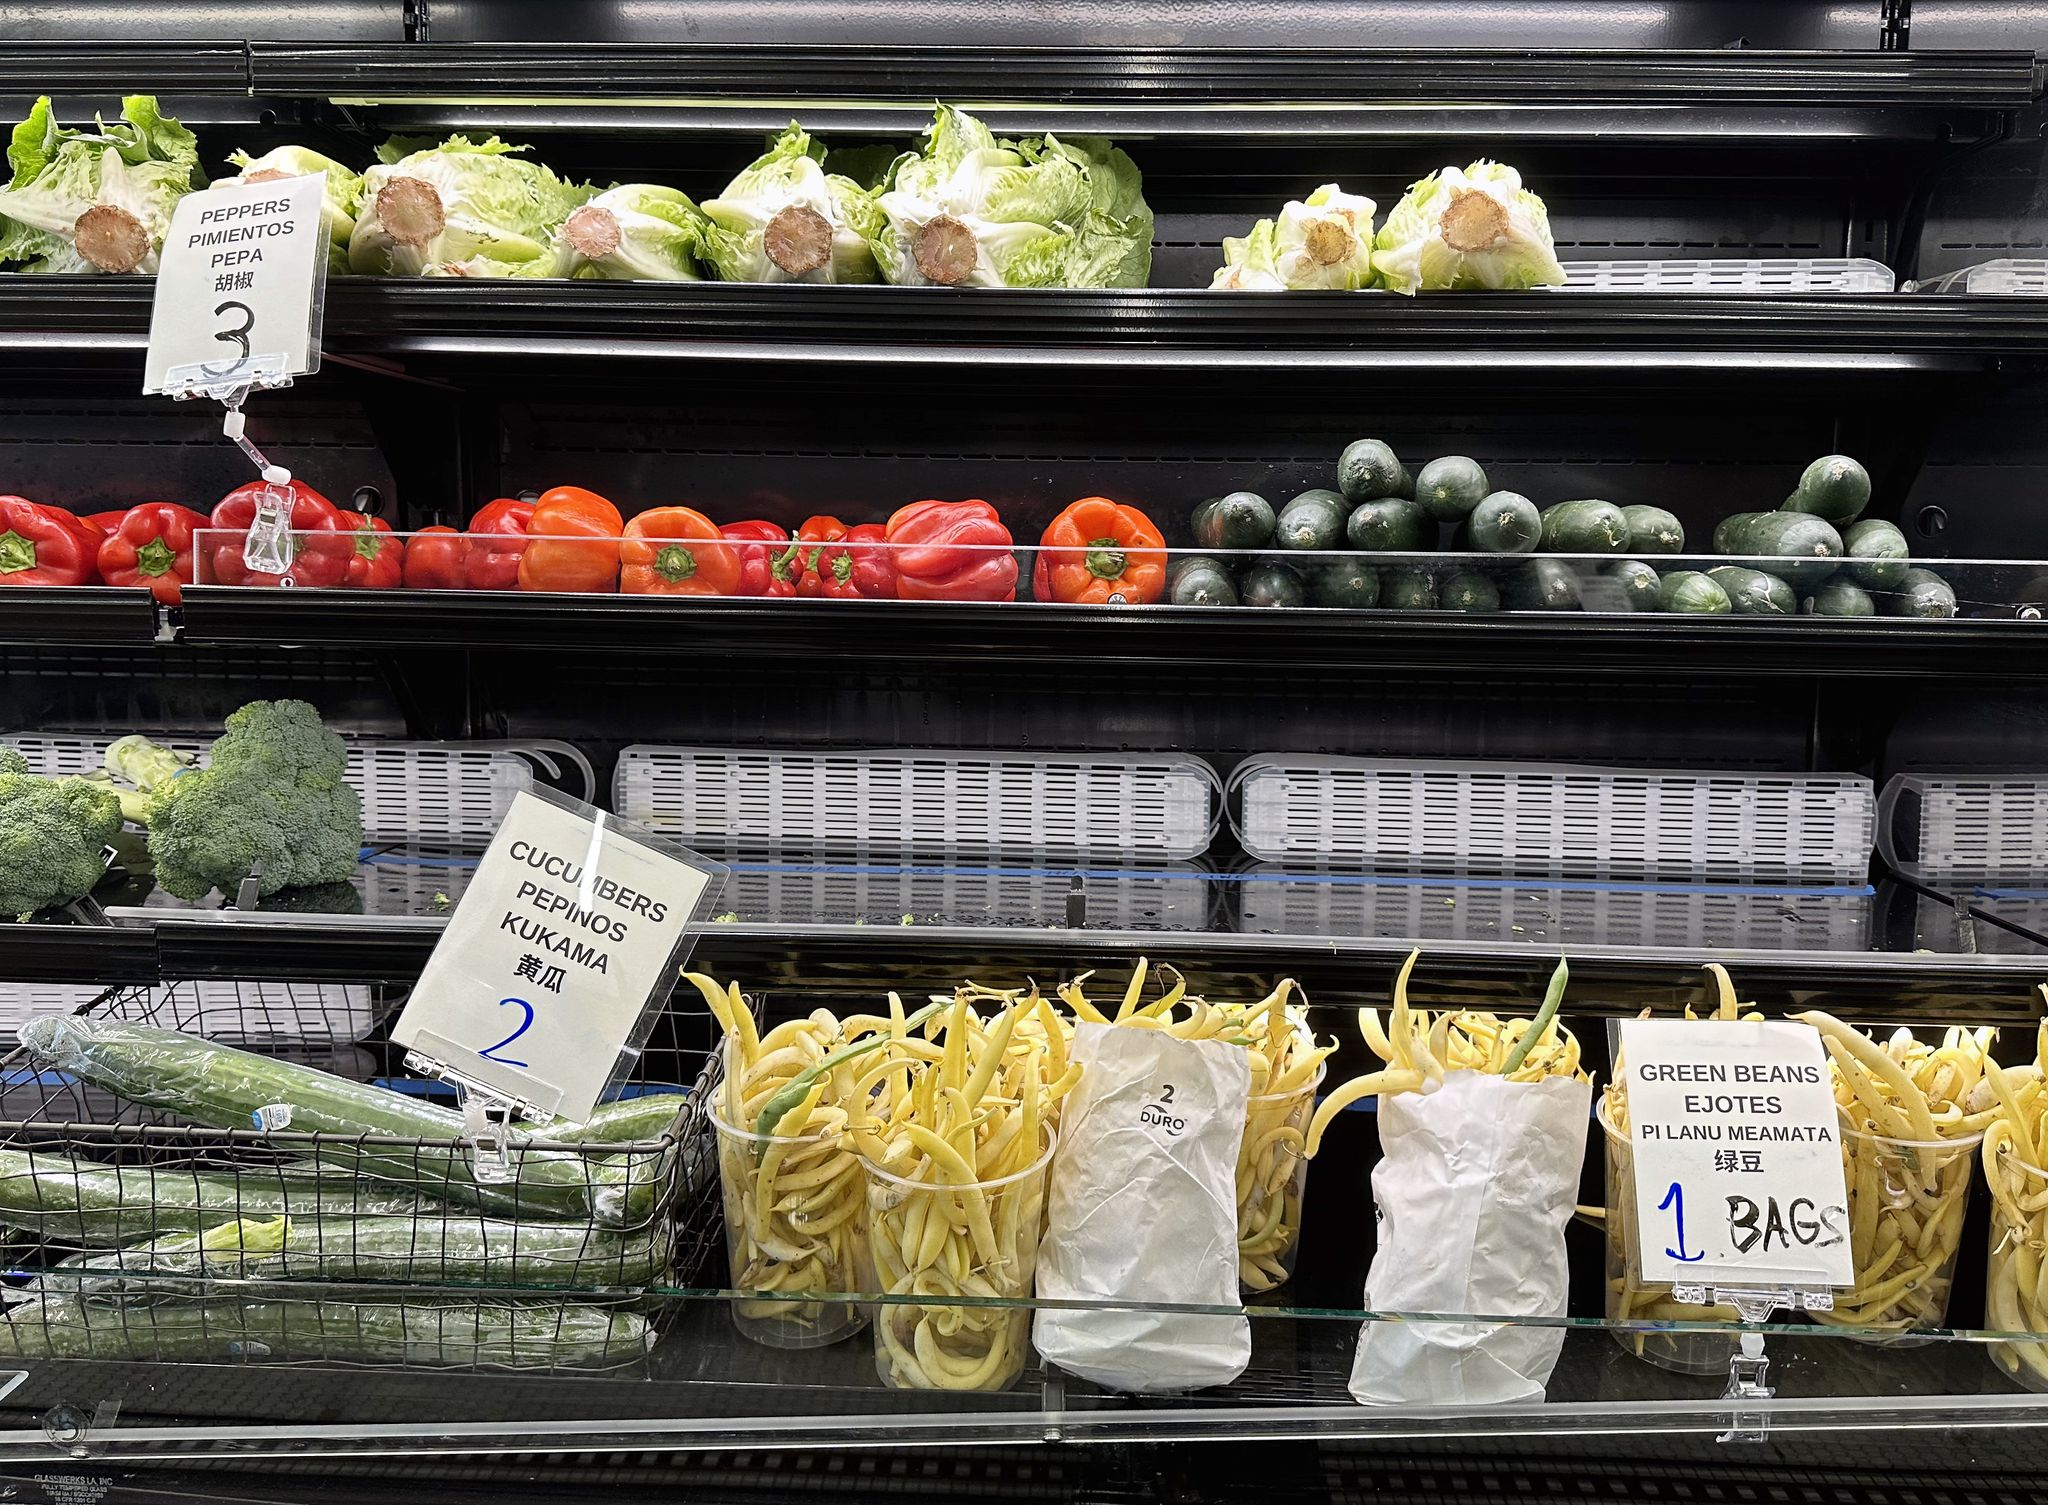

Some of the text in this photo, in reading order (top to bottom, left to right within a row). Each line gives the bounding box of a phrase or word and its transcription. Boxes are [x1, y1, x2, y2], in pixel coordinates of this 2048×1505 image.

[200, 198, 291, 225] PEPPERS
[188, 220, 295, 249] PIMIENTOS
[210, 248, 263, 268] PEPA
[214, 271, 254, 292] 胡椒
[200, 300, 255, 377] 3
[516, 880, 628, 943] PEPINOS
[500, 911, 608, 975] KUKAMA
[512, 953, 568, 995] 黄瓜
[478, 997, 535, 1068] 2
[1639, 1064, 1820, 1084] GREEN BEANS
[1160, 1084, 1175, 1104] 2
[1684, 1095, 1783, 1114] EJOTES
[1140, 1111, 1185, 1130] DURO
[1641, 1124, 1832, 1143] PI LANU MEAMATA
[1713, 1149, 1765, 1174] 绿豆
[1657, 1182, 1847, 1262] 1 BAGS
